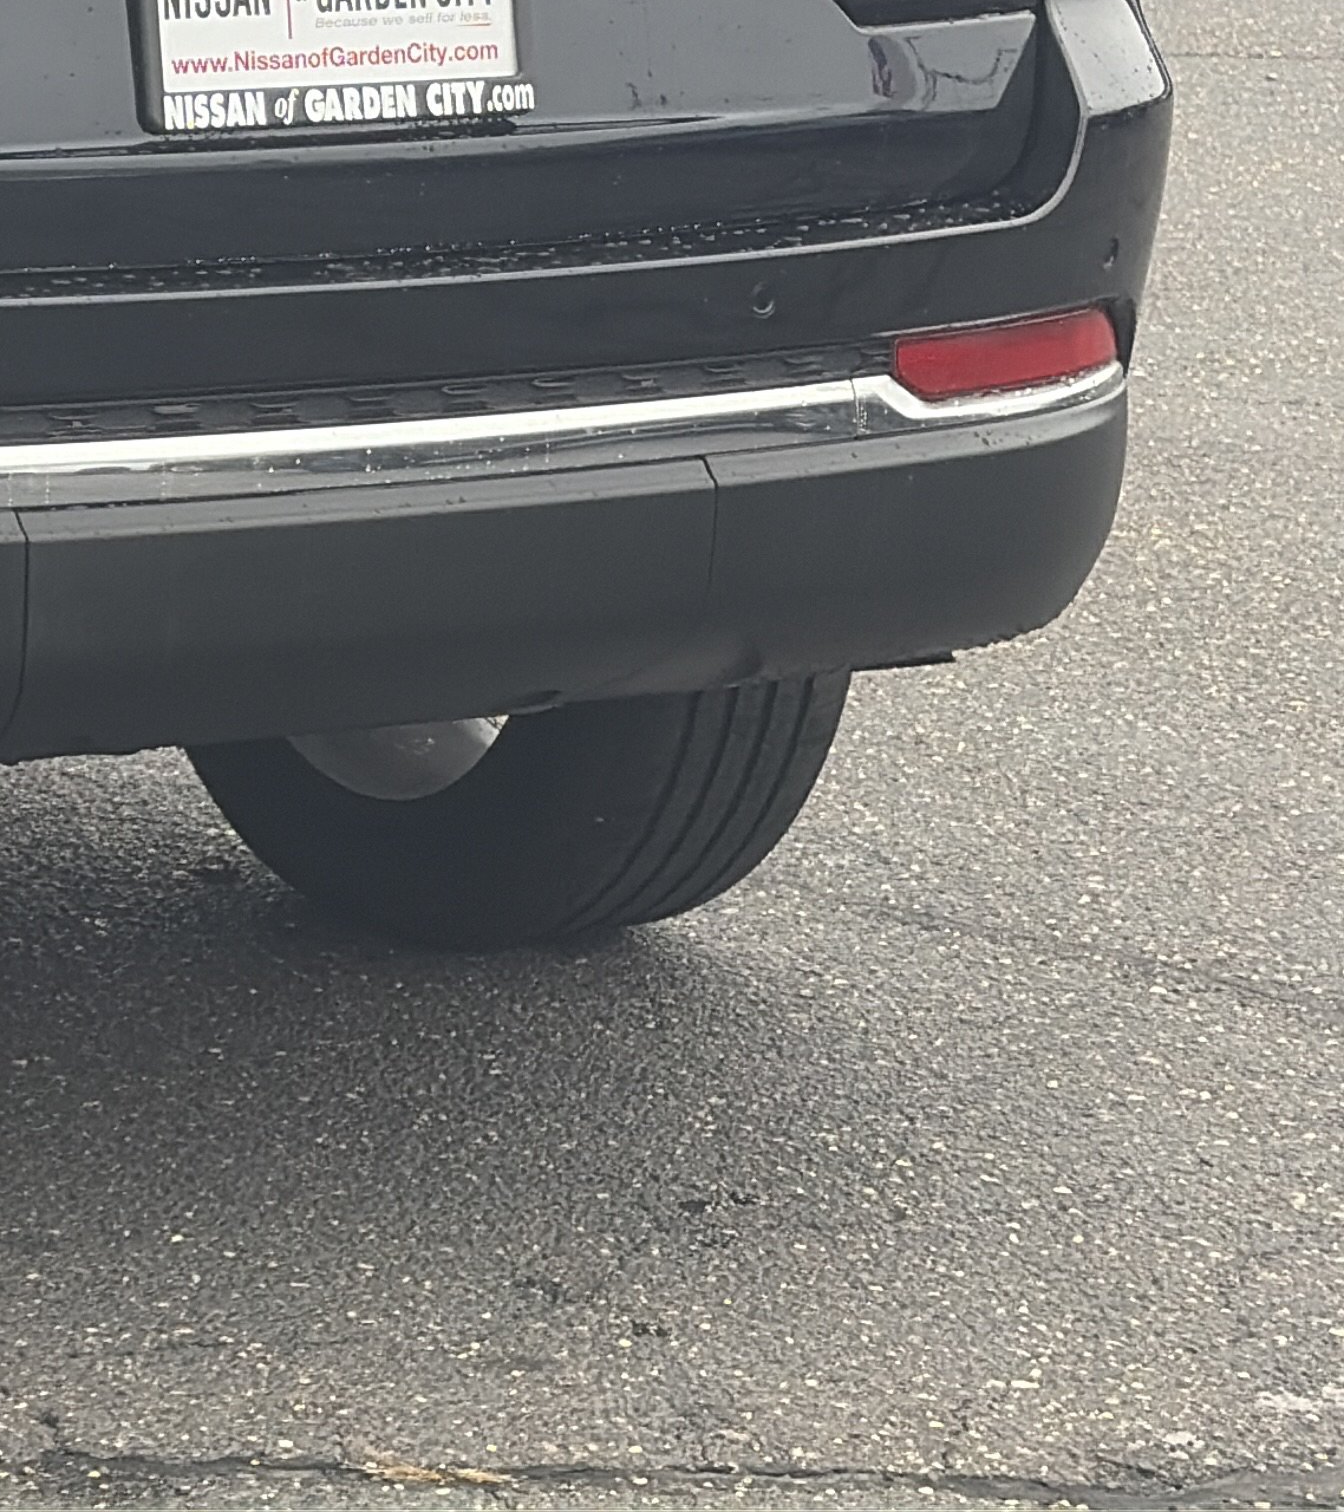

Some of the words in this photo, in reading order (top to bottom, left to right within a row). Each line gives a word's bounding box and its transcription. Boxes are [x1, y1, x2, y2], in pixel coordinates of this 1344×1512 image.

[315, 16, 378, 29] Because
[382, 15, 403, 25] we
[171, 43, 499, 75] www.NissanofGardenCity.com
[163, 92, 266, 130] NISSAN
[274, 89, 299, 125] of
[304, 85, 417, 123] GARDEN
[425, 80, 535, 116] CITY.com
